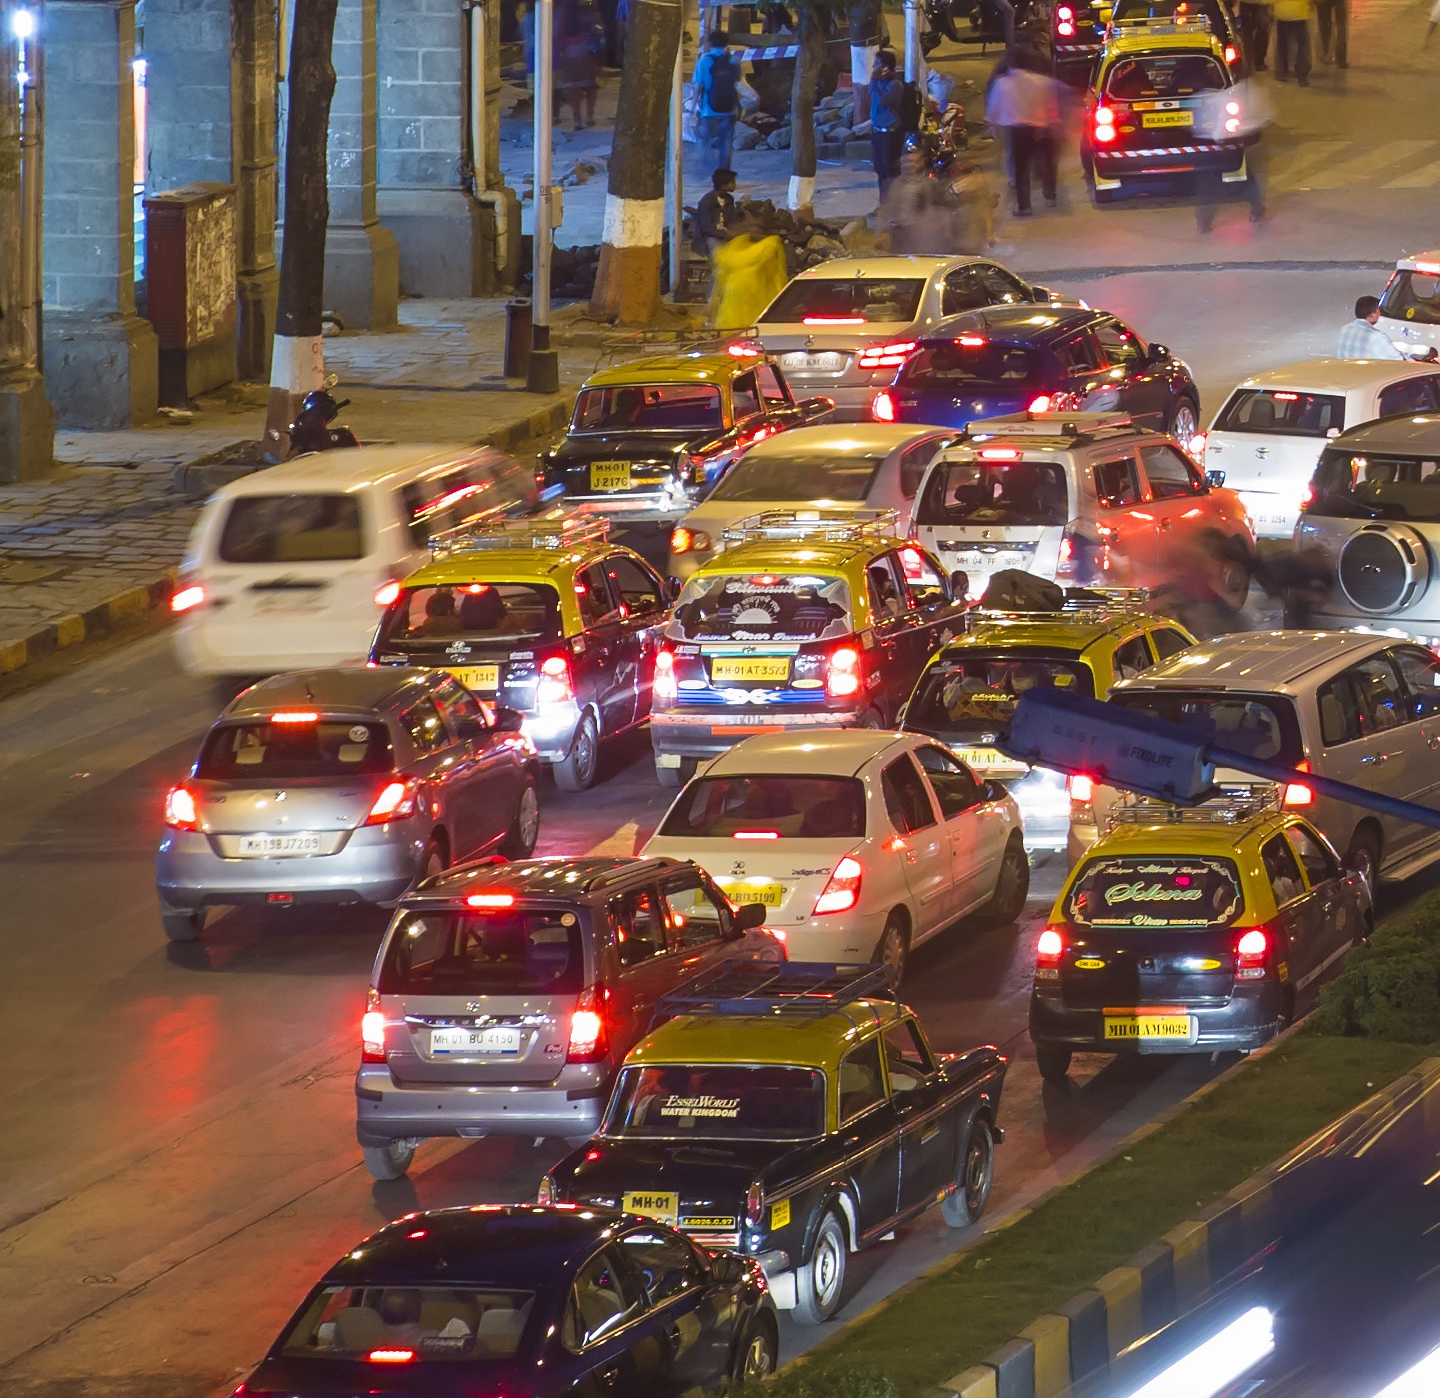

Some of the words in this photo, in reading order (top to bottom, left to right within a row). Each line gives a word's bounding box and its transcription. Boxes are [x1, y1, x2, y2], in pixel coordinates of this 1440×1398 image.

[1104, 881, 1203, 907] Selena
[433, 1034, 448, 1045] MH
[468, 1034, 484, 1044] BU
[661, 1107, 690, 1116] WATER
[690, 1107, 738, 1118] KINGDOM
